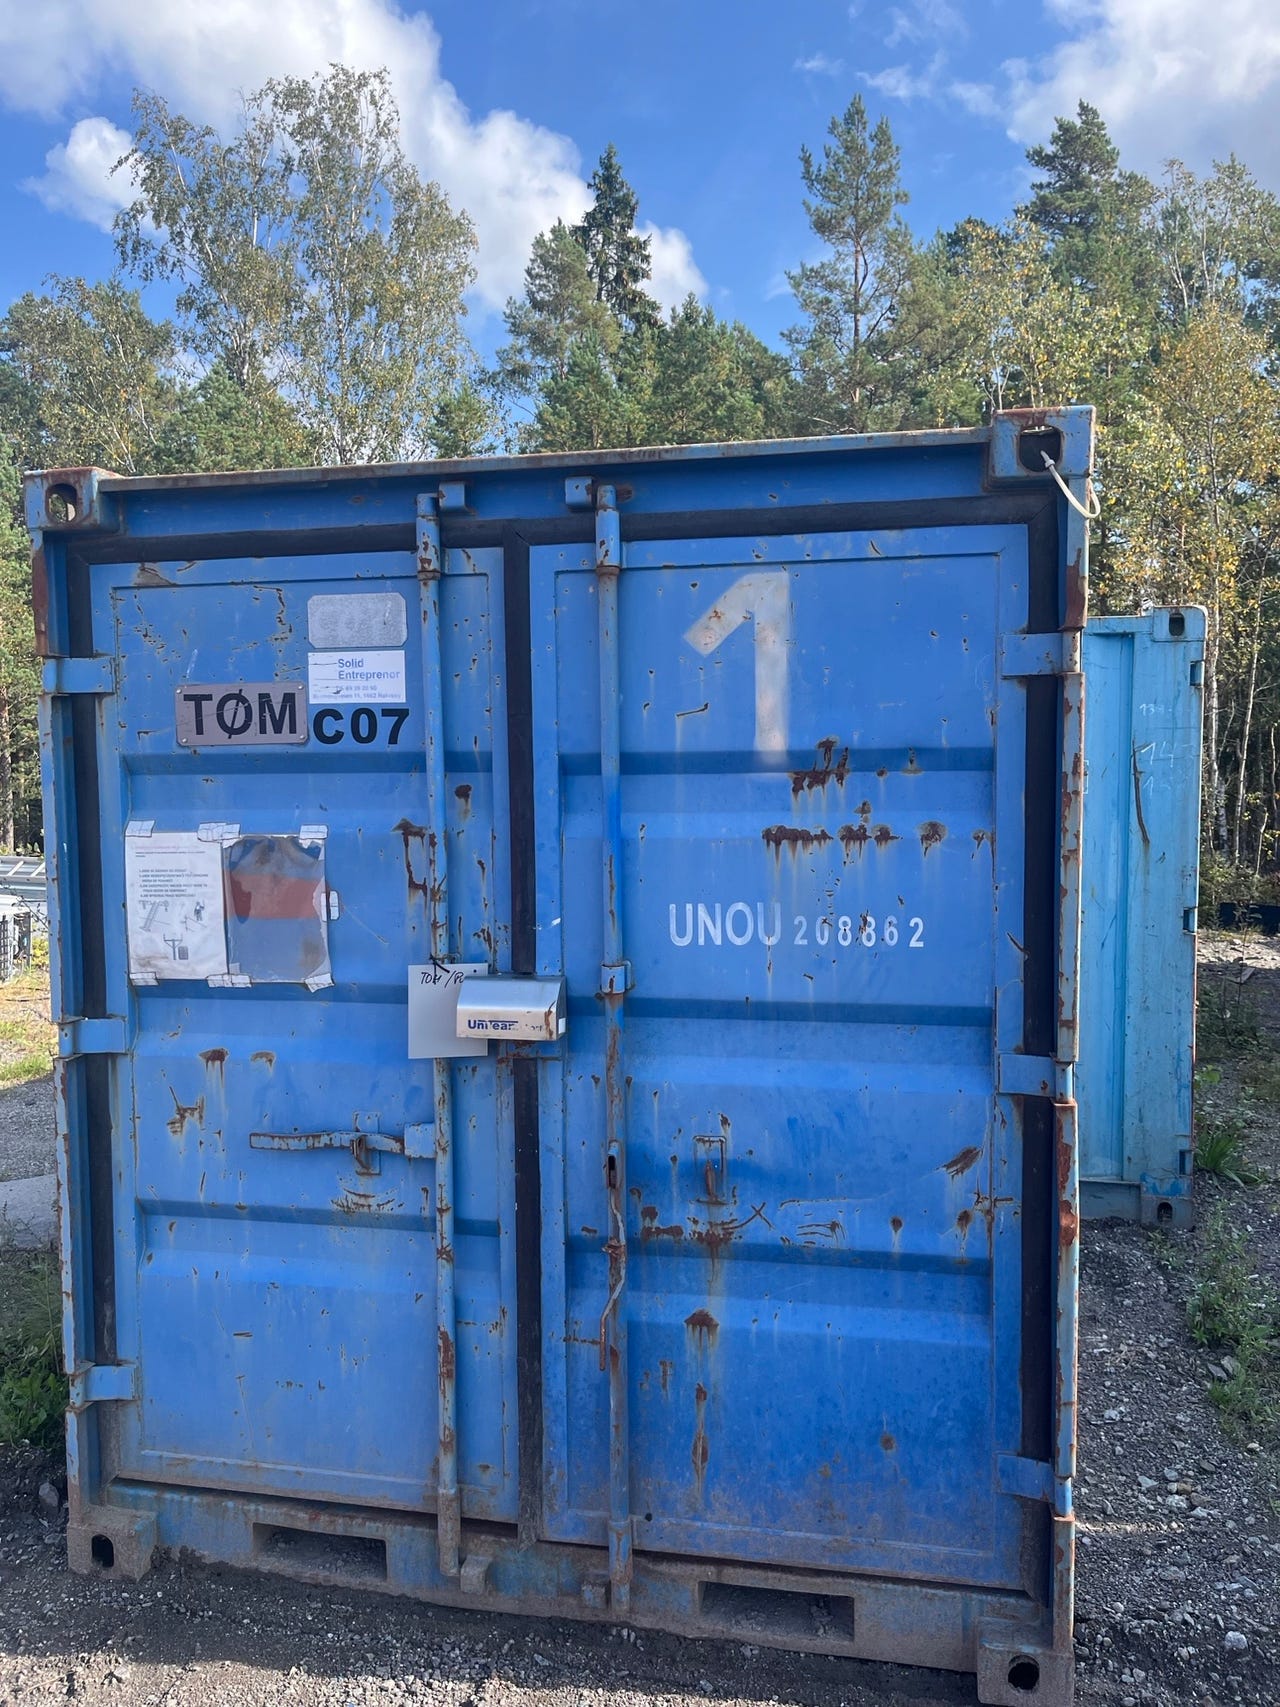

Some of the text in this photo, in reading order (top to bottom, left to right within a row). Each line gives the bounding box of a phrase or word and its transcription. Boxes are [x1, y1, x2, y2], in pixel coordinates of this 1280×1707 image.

[338, 658, 364, 668] Solid
[684, 571, 790, 764] 1
[183, 689, 297, 739] TØM
[669, 902, 924, 947] UNOU 208862
